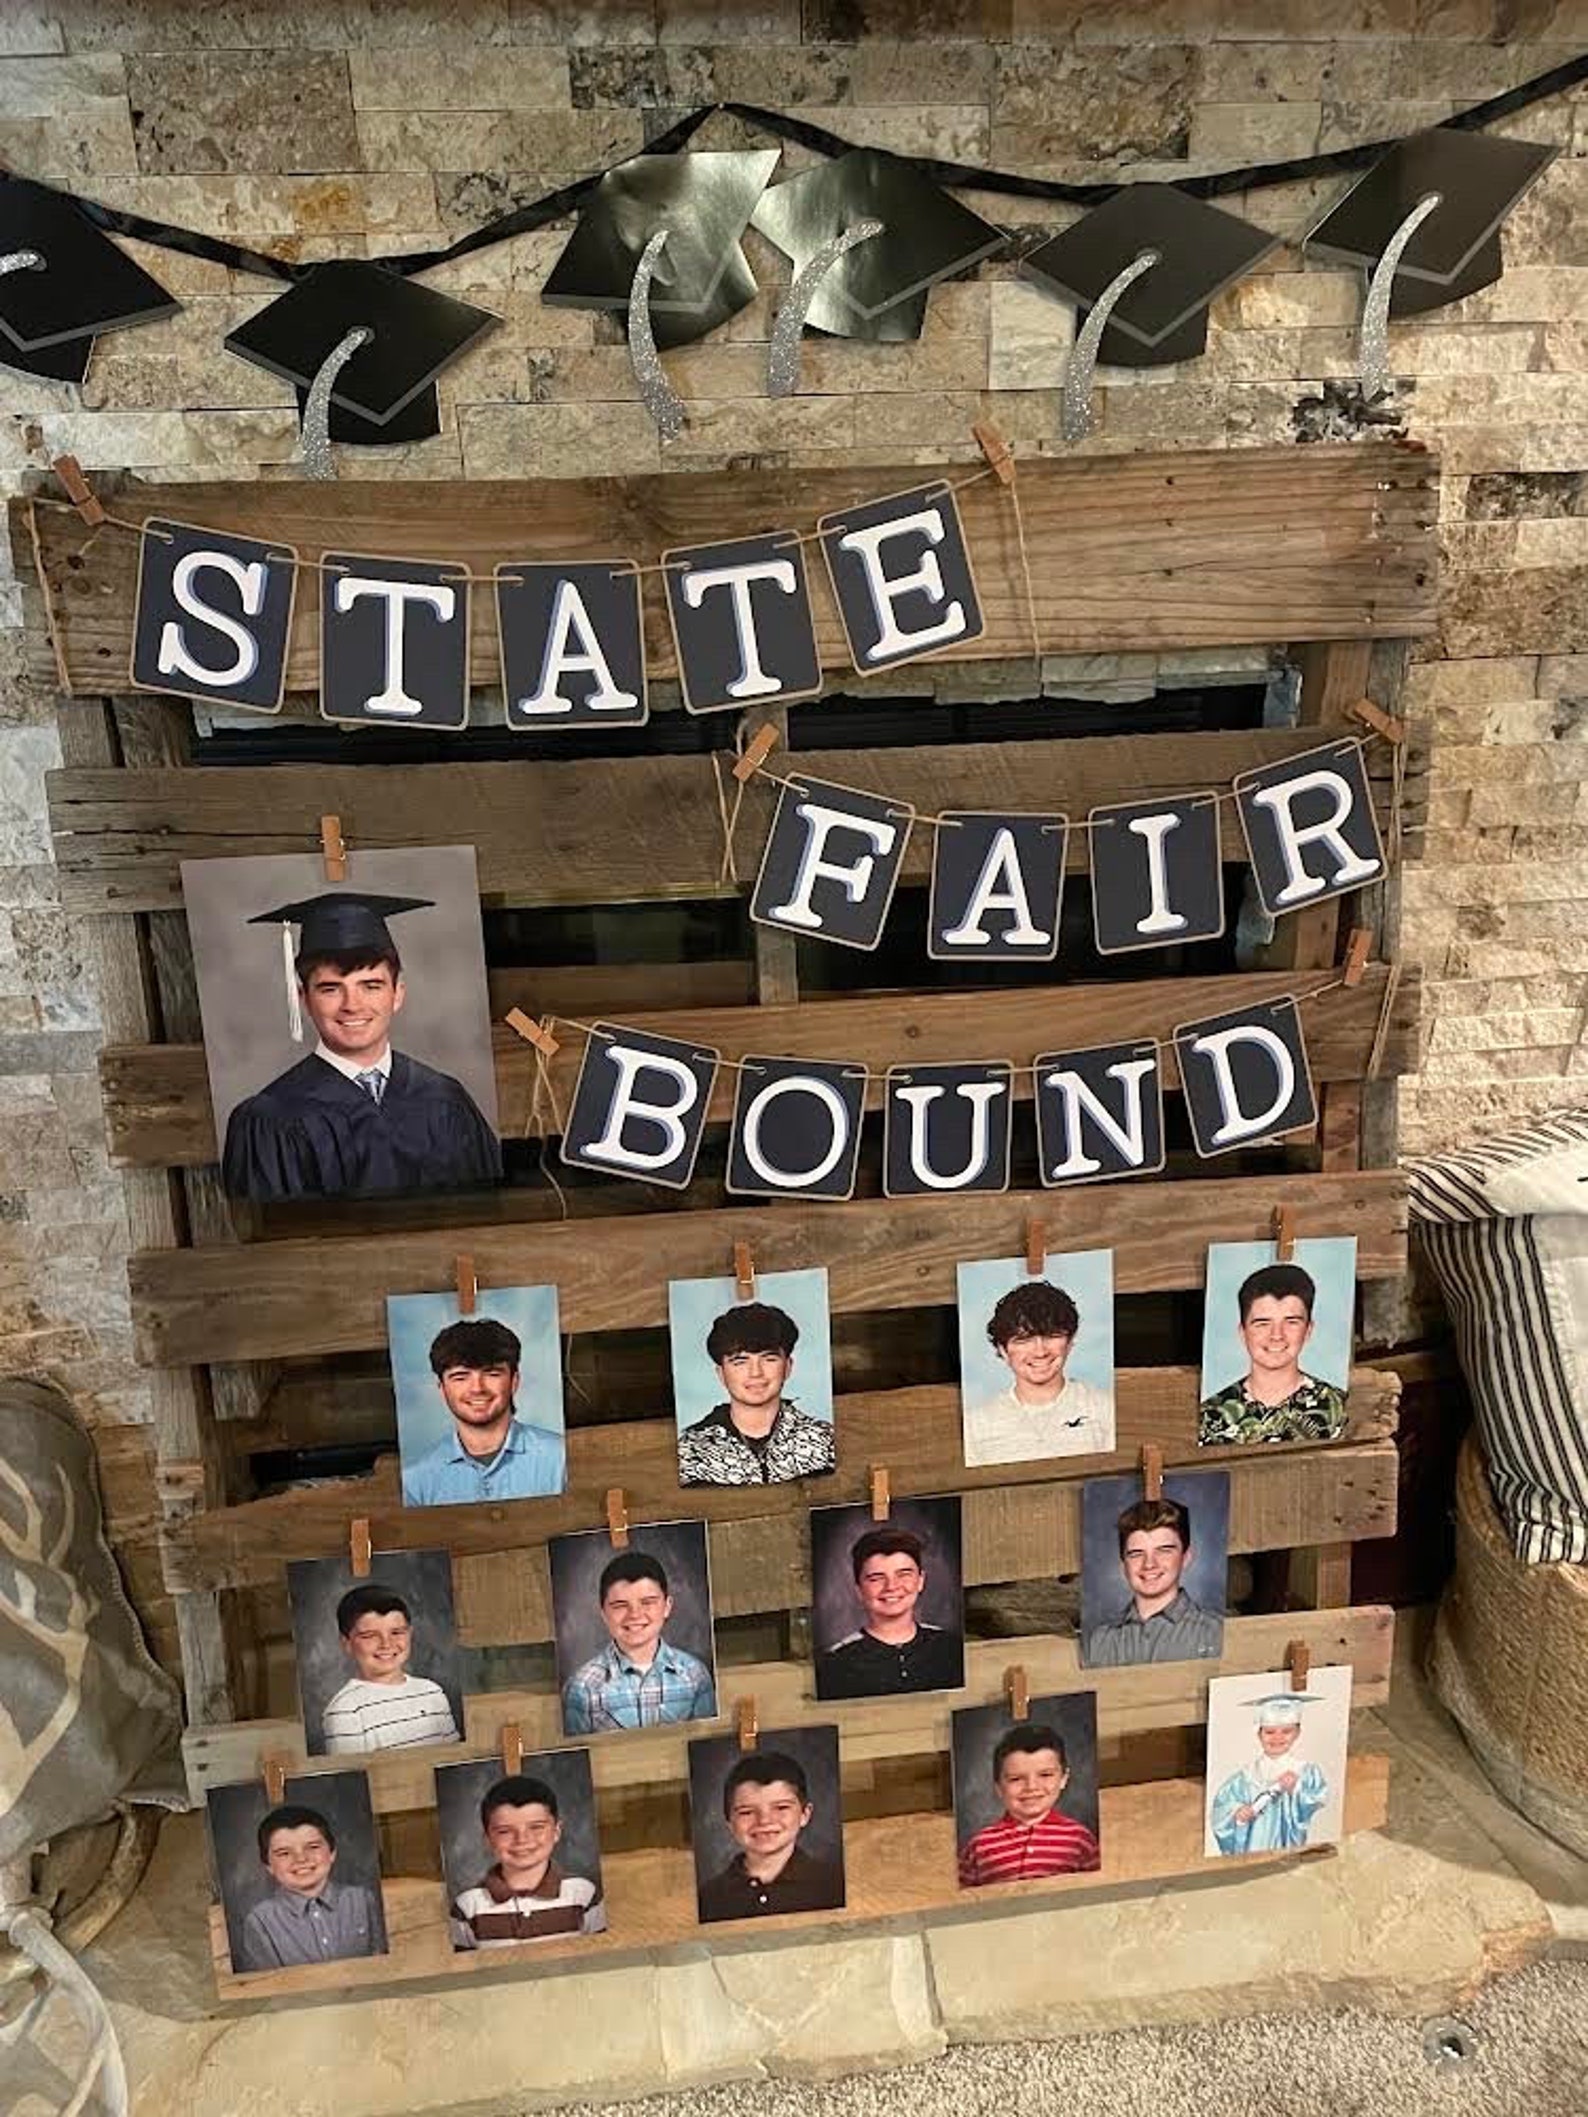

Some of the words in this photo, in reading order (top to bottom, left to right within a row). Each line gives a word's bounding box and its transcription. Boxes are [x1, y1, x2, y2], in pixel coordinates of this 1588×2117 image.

[156, 508, 966, 717] STATE
[769, 769, 1381, 946] FAIR
[579, 1024, 1296, 1188] BOUND
